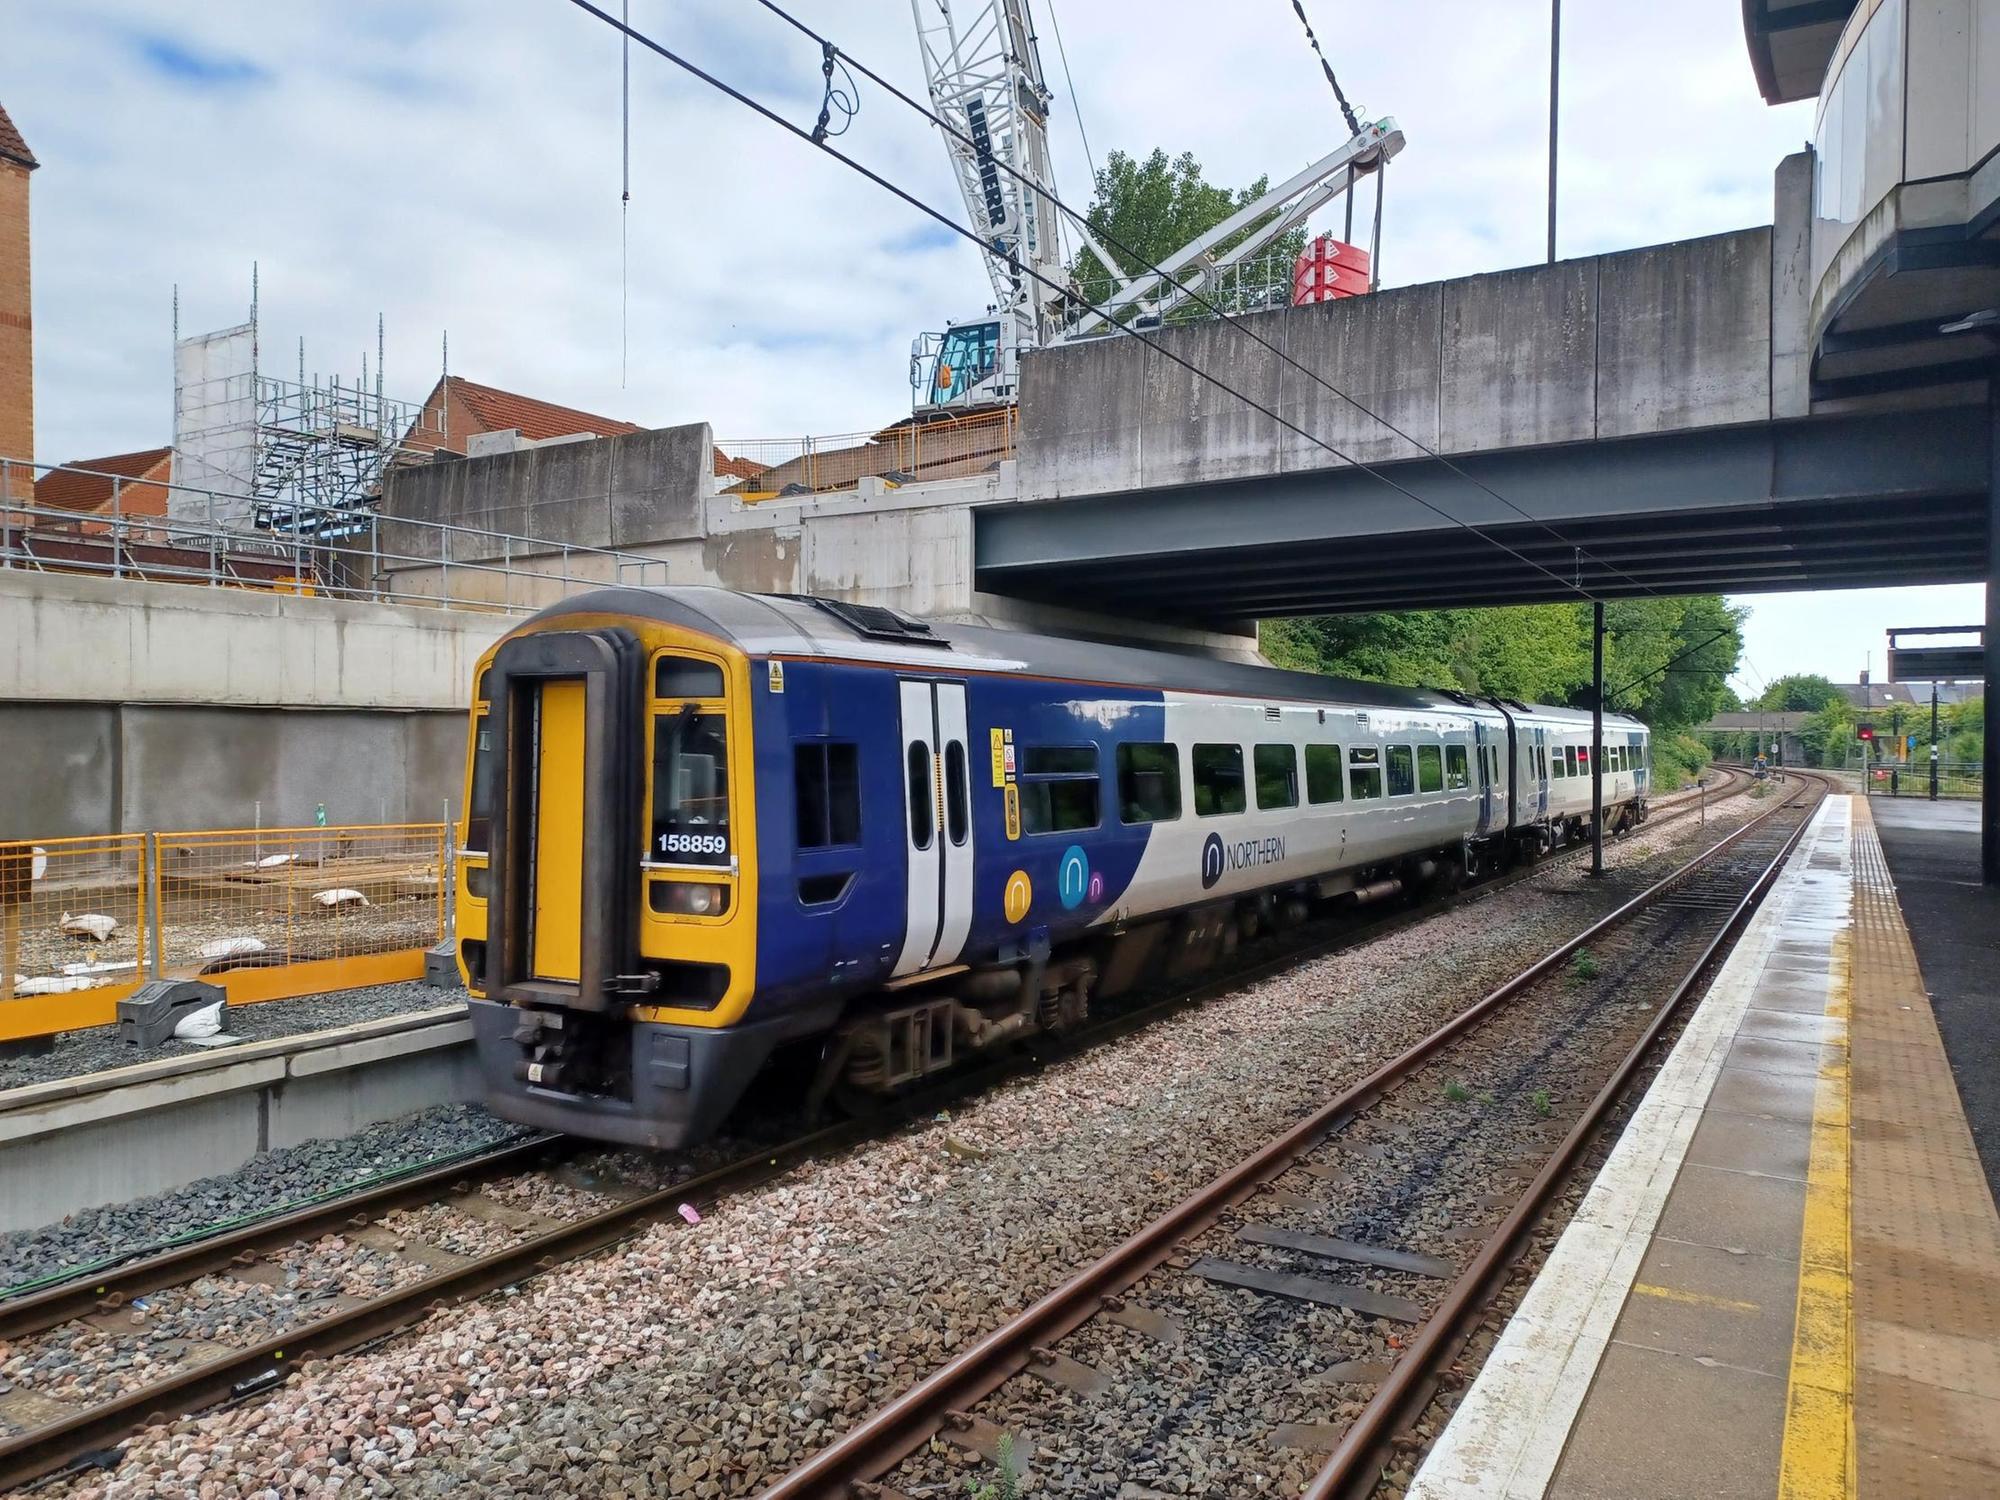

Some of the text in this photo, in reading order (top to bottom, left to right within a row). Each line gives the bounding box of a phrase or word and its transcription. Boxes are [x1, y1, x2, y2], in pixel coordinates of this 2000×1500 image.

[966, 99, 1006, 229] LIEBHERR
[658, 833, 726, 854] 158859
[1226, 836, 1285, 871] NORTHERN
